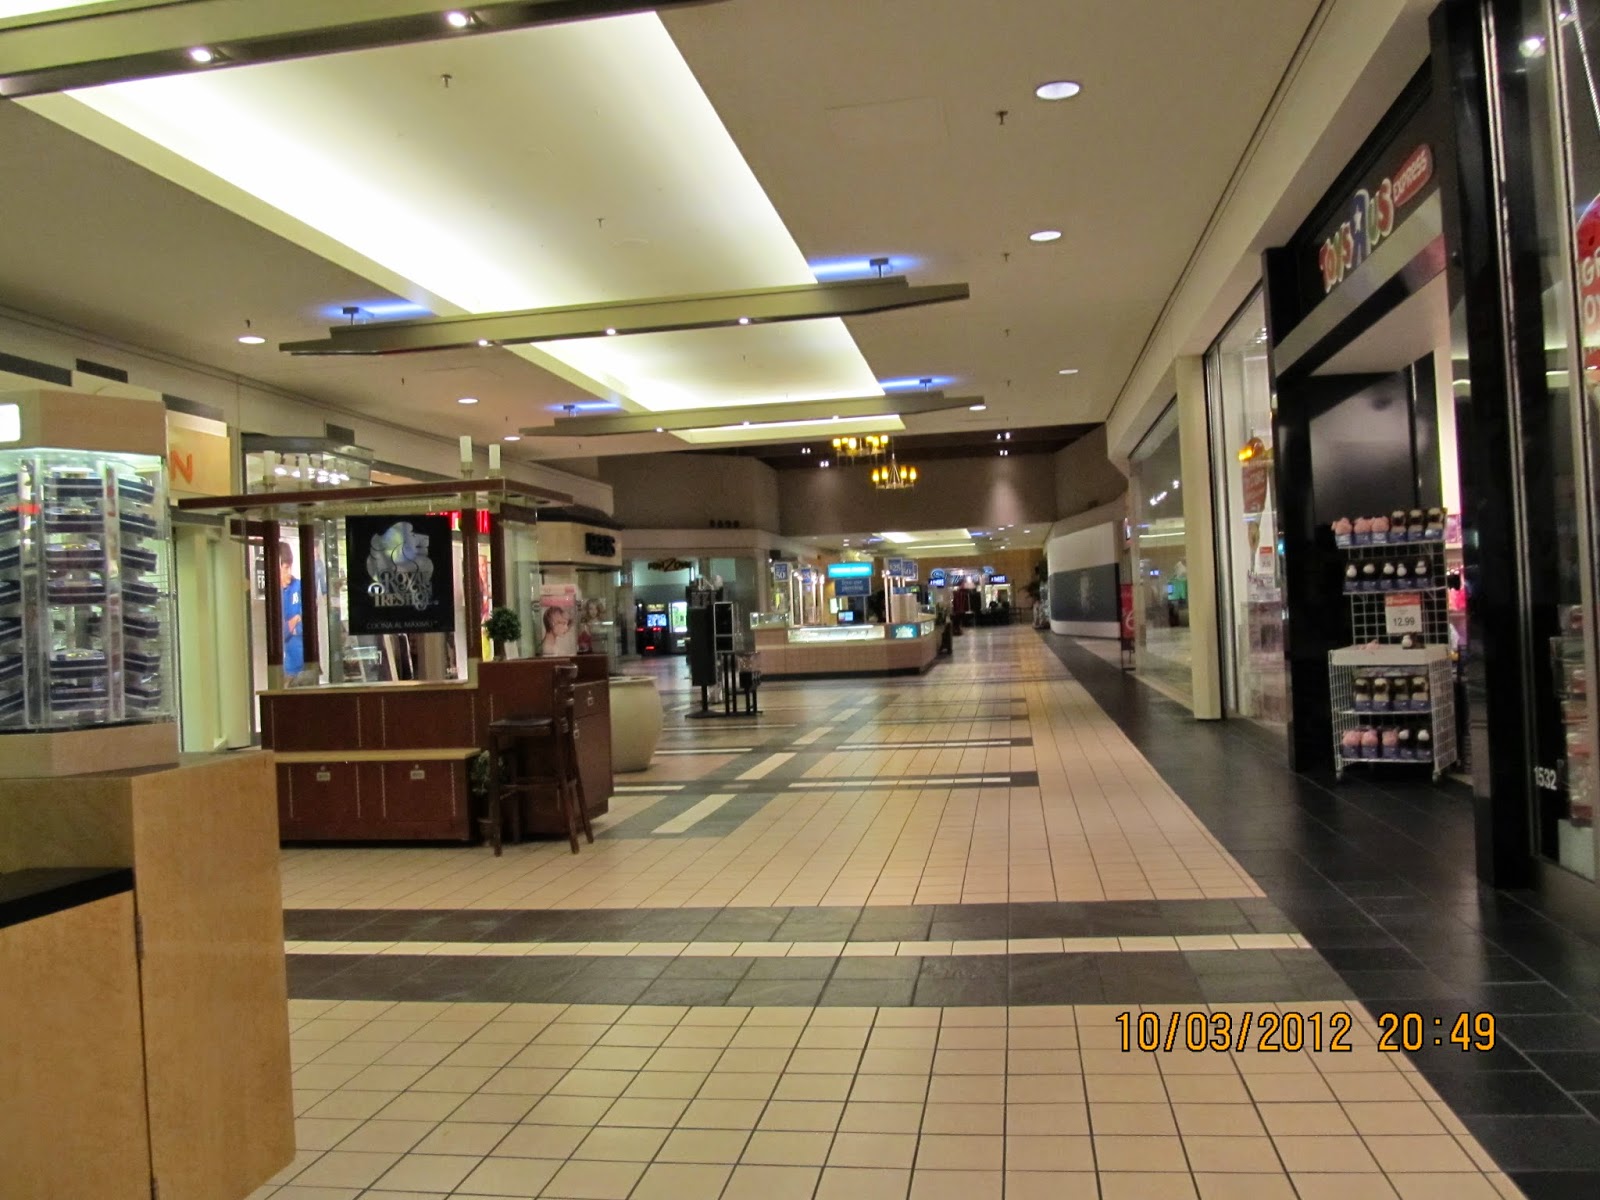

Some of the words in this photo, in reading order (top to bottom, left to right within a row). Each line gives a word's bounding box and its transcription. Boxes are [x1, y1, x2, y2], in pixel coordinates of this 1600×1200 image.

[1393, 148, 1427, 206] EXPRESS
[1393, 616, 1415, 627] 12.99
[1534, 766, 1557, 791] 1532
